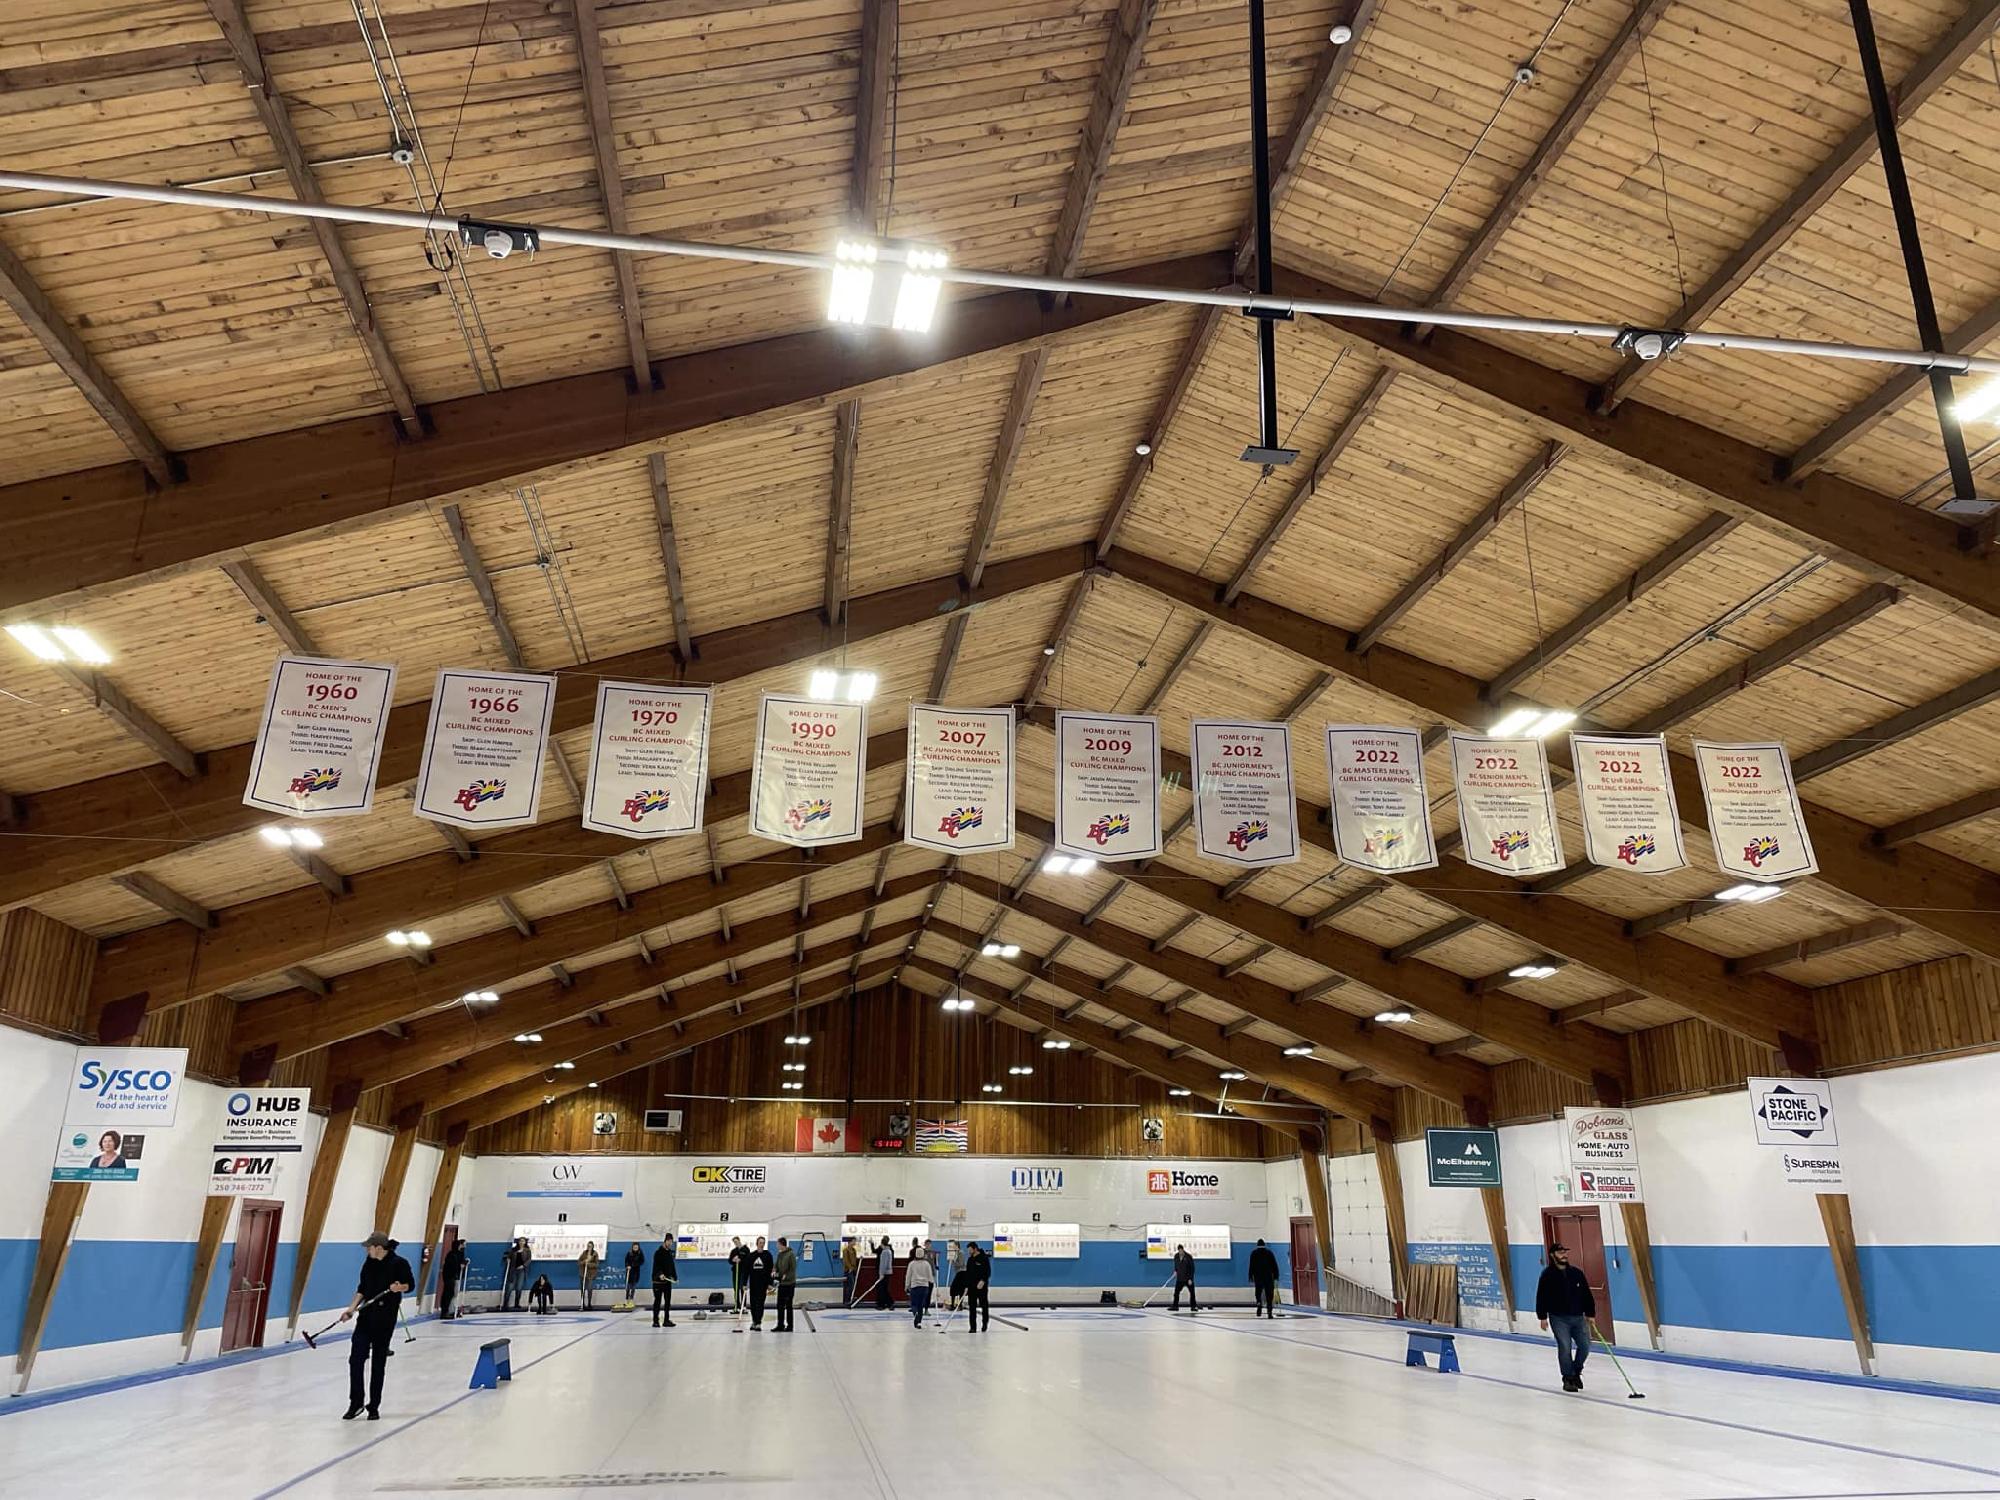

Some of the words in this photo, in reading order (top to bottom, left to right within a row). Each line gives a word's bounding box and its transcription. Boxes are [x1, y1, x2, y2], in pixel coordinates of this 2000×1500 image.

[305, 672, 334, 680] HOME
[306, 683, 358, 701] 1960
[468, 685, 493, 694] HOME
[495, 687, 505, 695] OF
[508, 688, 524, 696] THE
[470, 697, 520, 714] 1966
[629, 699, 653, 707] HOME
[281, 709, 318, 719] CURLING
[319, 712, 372, 724] CHAMPIONS
[484, 717, 511, 725] MIXED
[631, 709, 678, 727] 1970
[937, 719, 959, 727] HOME
[446, 722, 482, 732] CURLING
[484, 725, 534, 736] CHAMPIONS
[790, 722, 836, 740] 1990
[1083, 727, 1105, 735] HOME
[609, 734, 644, 743] CURLING
[939, 730, 986, 748] 2007
[772, 746, 804, 755] CURLING
[805, 748, 851, 757] CHAMPIONS
[1085, 738, 1132, 755] 2009
[1222, 745, 1263, 757] 2012
[963, 749, 1001, 757] WOMEN'S
[1356, 750, 1399, 763] 2022
[923, 754, 955, 762] CURLING
[956, 756, 1001, 765] CHAMPIONS
[1475, 758, 1518, 770] 2022
[1070, 762, 1101, 770] CURLING
[1102, 764, 1146, 772] CHAMPIONS
[1599, 760, 1642, 774] 2022
[1721, 766, 1762, 778] 2022
[1238, 771, 1281, 779] CHAMPIONS
[1373, 776, 1415, 784] CHAMPIONS
[1463, 780, 1493, 788] CURLING
[1587, 784, 1617, 792] CURLING
[108, 1093, 117, 1101] At
[119, 1093, 133, 1101] the
[135, 1093, 158, 1101] heart
[96, 1102, 117, 1110] food
[256, 1097, 301, 1112] HUB
[1769, 1099, 1807, 1110] STONE
[1771, 1110, 1816, 1121] PACIFIC
[226, 1118, 297, 1127] INSURANCE
[1576, 1115, 1624, 1134] Dobson's
[1594, 1132, 1628, 1140] GLASS
[1437, 1158, 1492, 1167] McElhanney
[1791, 1159, 1839, 1169] SURESPAN
[553, 1165, 582, 1180] CW
[694, 1167, 727, 1182] OK
[733, 1169, 763, 1180] TIRE
[1013, 1167, 1061, 1190] DIW
[1172, 1171, 1219, 1186] Home
[1597, 1177, 1634, 1185] RIDDELL
[708, 1185, 730, 1193] auto
[733, 1185, 765, 1193] service
